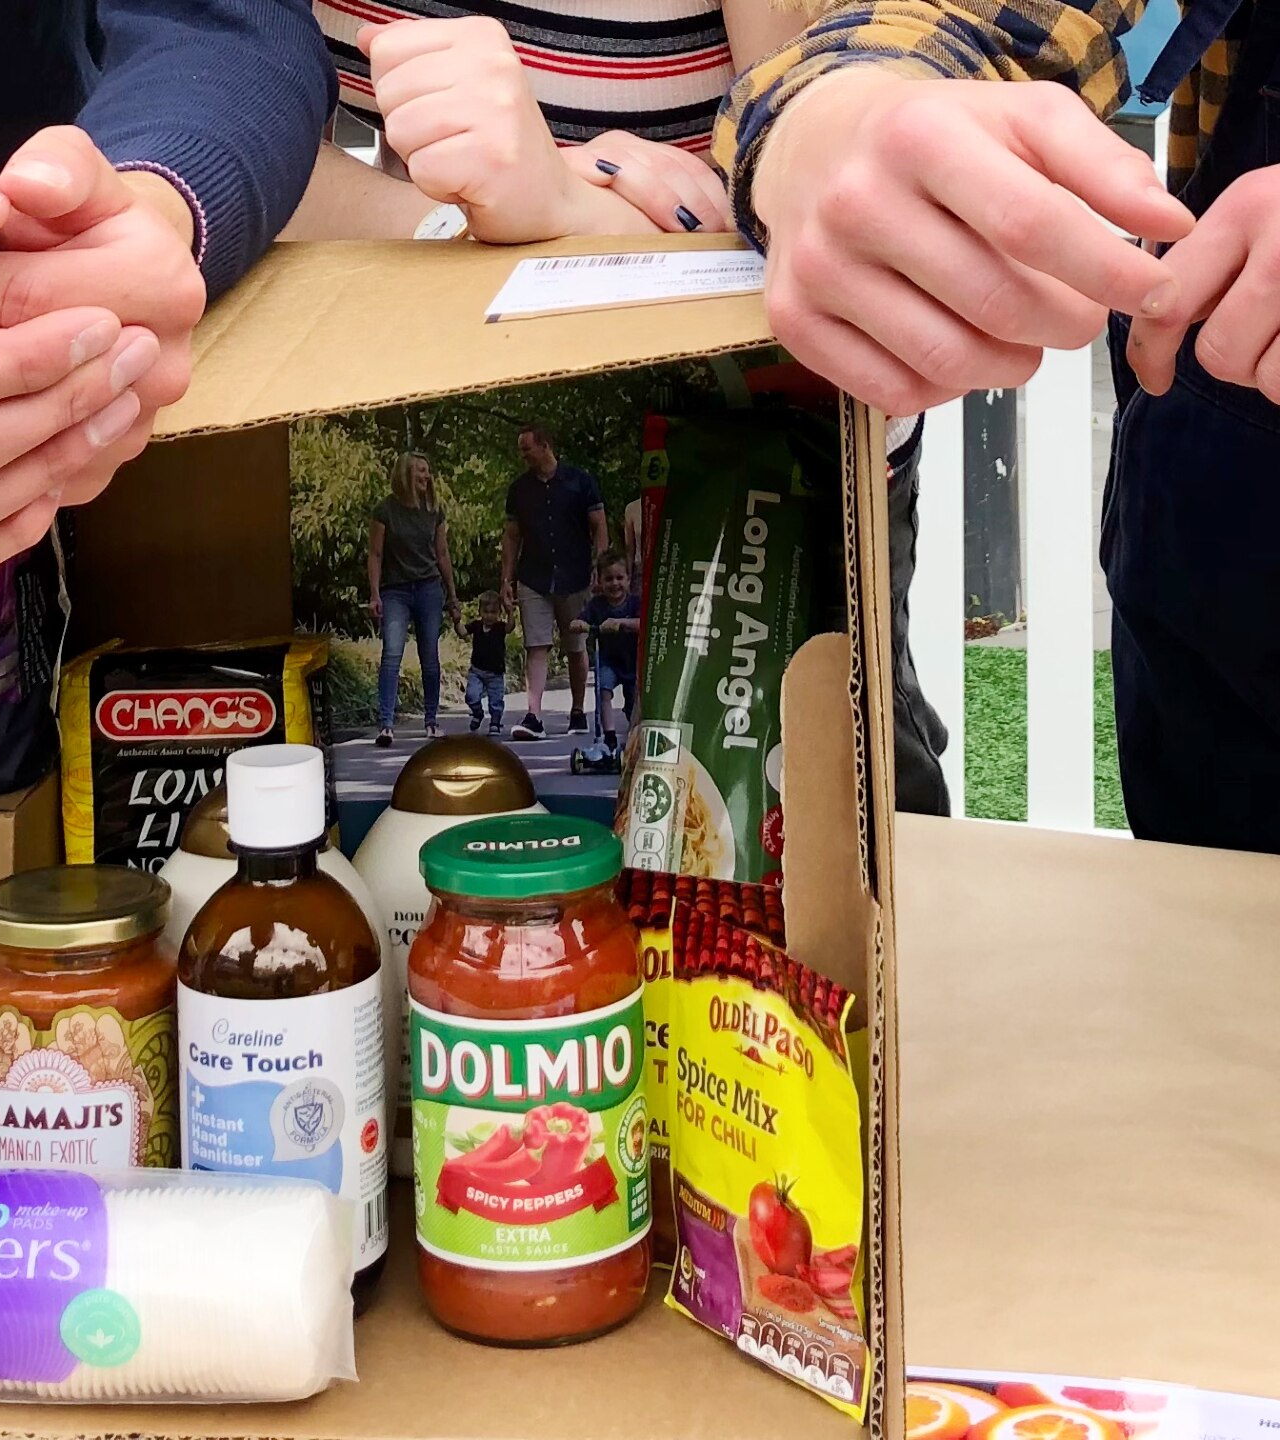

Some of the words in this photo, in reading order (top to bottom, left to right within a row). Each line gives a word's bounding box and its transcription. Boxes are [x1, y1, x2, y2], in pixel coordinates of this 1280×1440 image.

[727, 489, 781, 604] Long
[652, 576, 665, 623] tomato
[683, 560, 727, 656] Hair
[716, 610, 770, 750] Angel
[110, 696, 262, 732] CHANG'S
[116, 746, 158, 758] Authentic
[185, 745, 220, 758] Cooking
[466, 835, 582, 852] DOLMIO
[189, 1041, 234, 1071] Care
[241, 1049, 324, 1073] Touch
[419, 1024, 634, 1100] DOLMIO
[677, 1046, 728, 1108] Spice
[731, 1079, 779, 1135] Mix
[191, 1106, 245, 1132] Instant
[676, 1089, 706, 1132] FOR
[710, 1114, 758, 1162] CHILI
[191, 1125, 228, 1147] Hand
[288, 1125, 330, 1145] FORMULA
[50, 1137, 99, 1165] EXOTIC
[192, 1141, 264, 1167] Sanitiser
[14, 1201, 89, 1220] make-up
[466, 1185, 510, 1211] SPICY
[512, 1183, 584, 1212] PEPPERS
[678, 1184, 712, 1222] MEDIUM
[13, 1217, 54, 1232] PADS
[495, 1226, 552, 1244] EXTRA
[480, 1243, 521, 1256] PASTA
[525, 1242, 569, 1256] SAUCE
